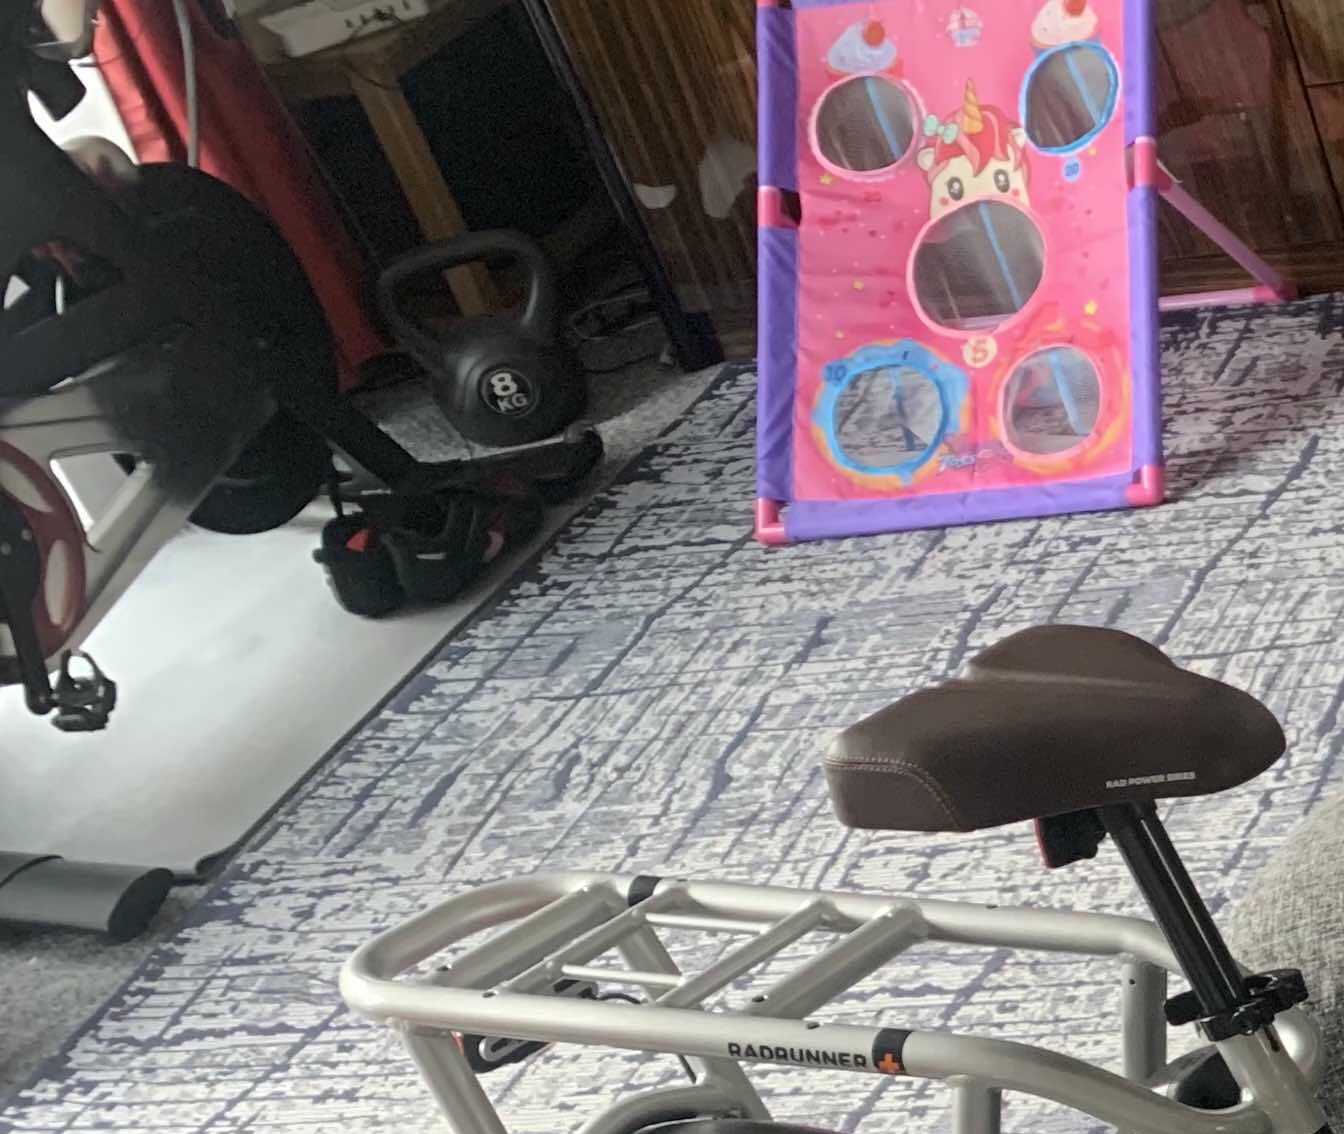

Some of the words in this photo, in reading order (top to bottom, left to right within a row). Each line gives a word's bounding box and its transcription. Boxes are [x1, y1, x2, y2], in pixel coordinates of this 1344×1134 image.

[491, 373, 517, 396] 8
[497, 393, 527, 412] KG
[727, 1042, 867, 1068] RADRUNNER
